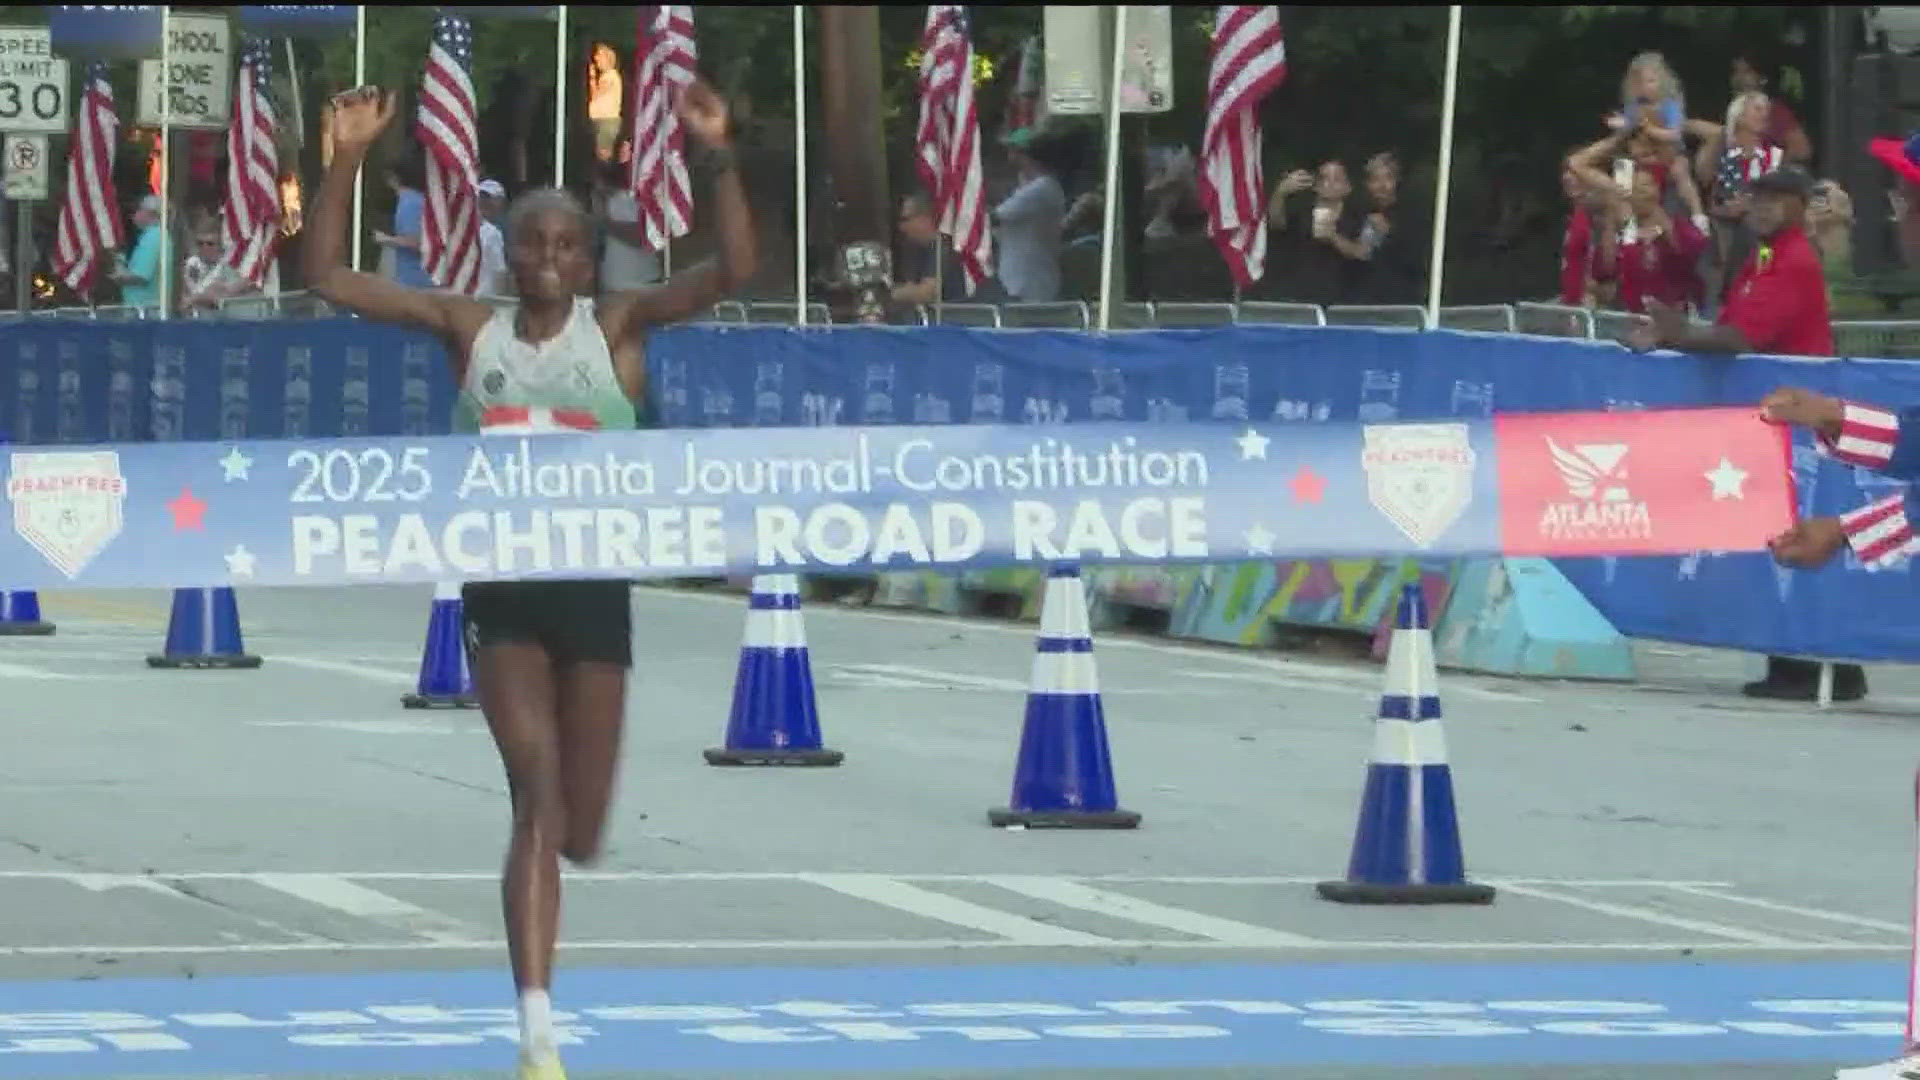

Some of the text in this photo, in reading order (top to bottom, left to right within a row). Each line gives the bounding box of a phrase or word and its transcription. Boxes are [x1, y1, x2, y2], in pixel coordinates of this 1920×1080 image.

[0, 38, 48, 55] SPEE
[167, 31, 224, 53] HOOL
[1, 61, 52, 78] LIMIT
[0, 81, 60, 119] 30
[288, 434, 1208, 502] 2025 Atlanta Journal-Constitution
[1541, 501, 1649, 525] ATLANTA
[292, 497, 1209, 574] PEACHTREE ROAD RACE
